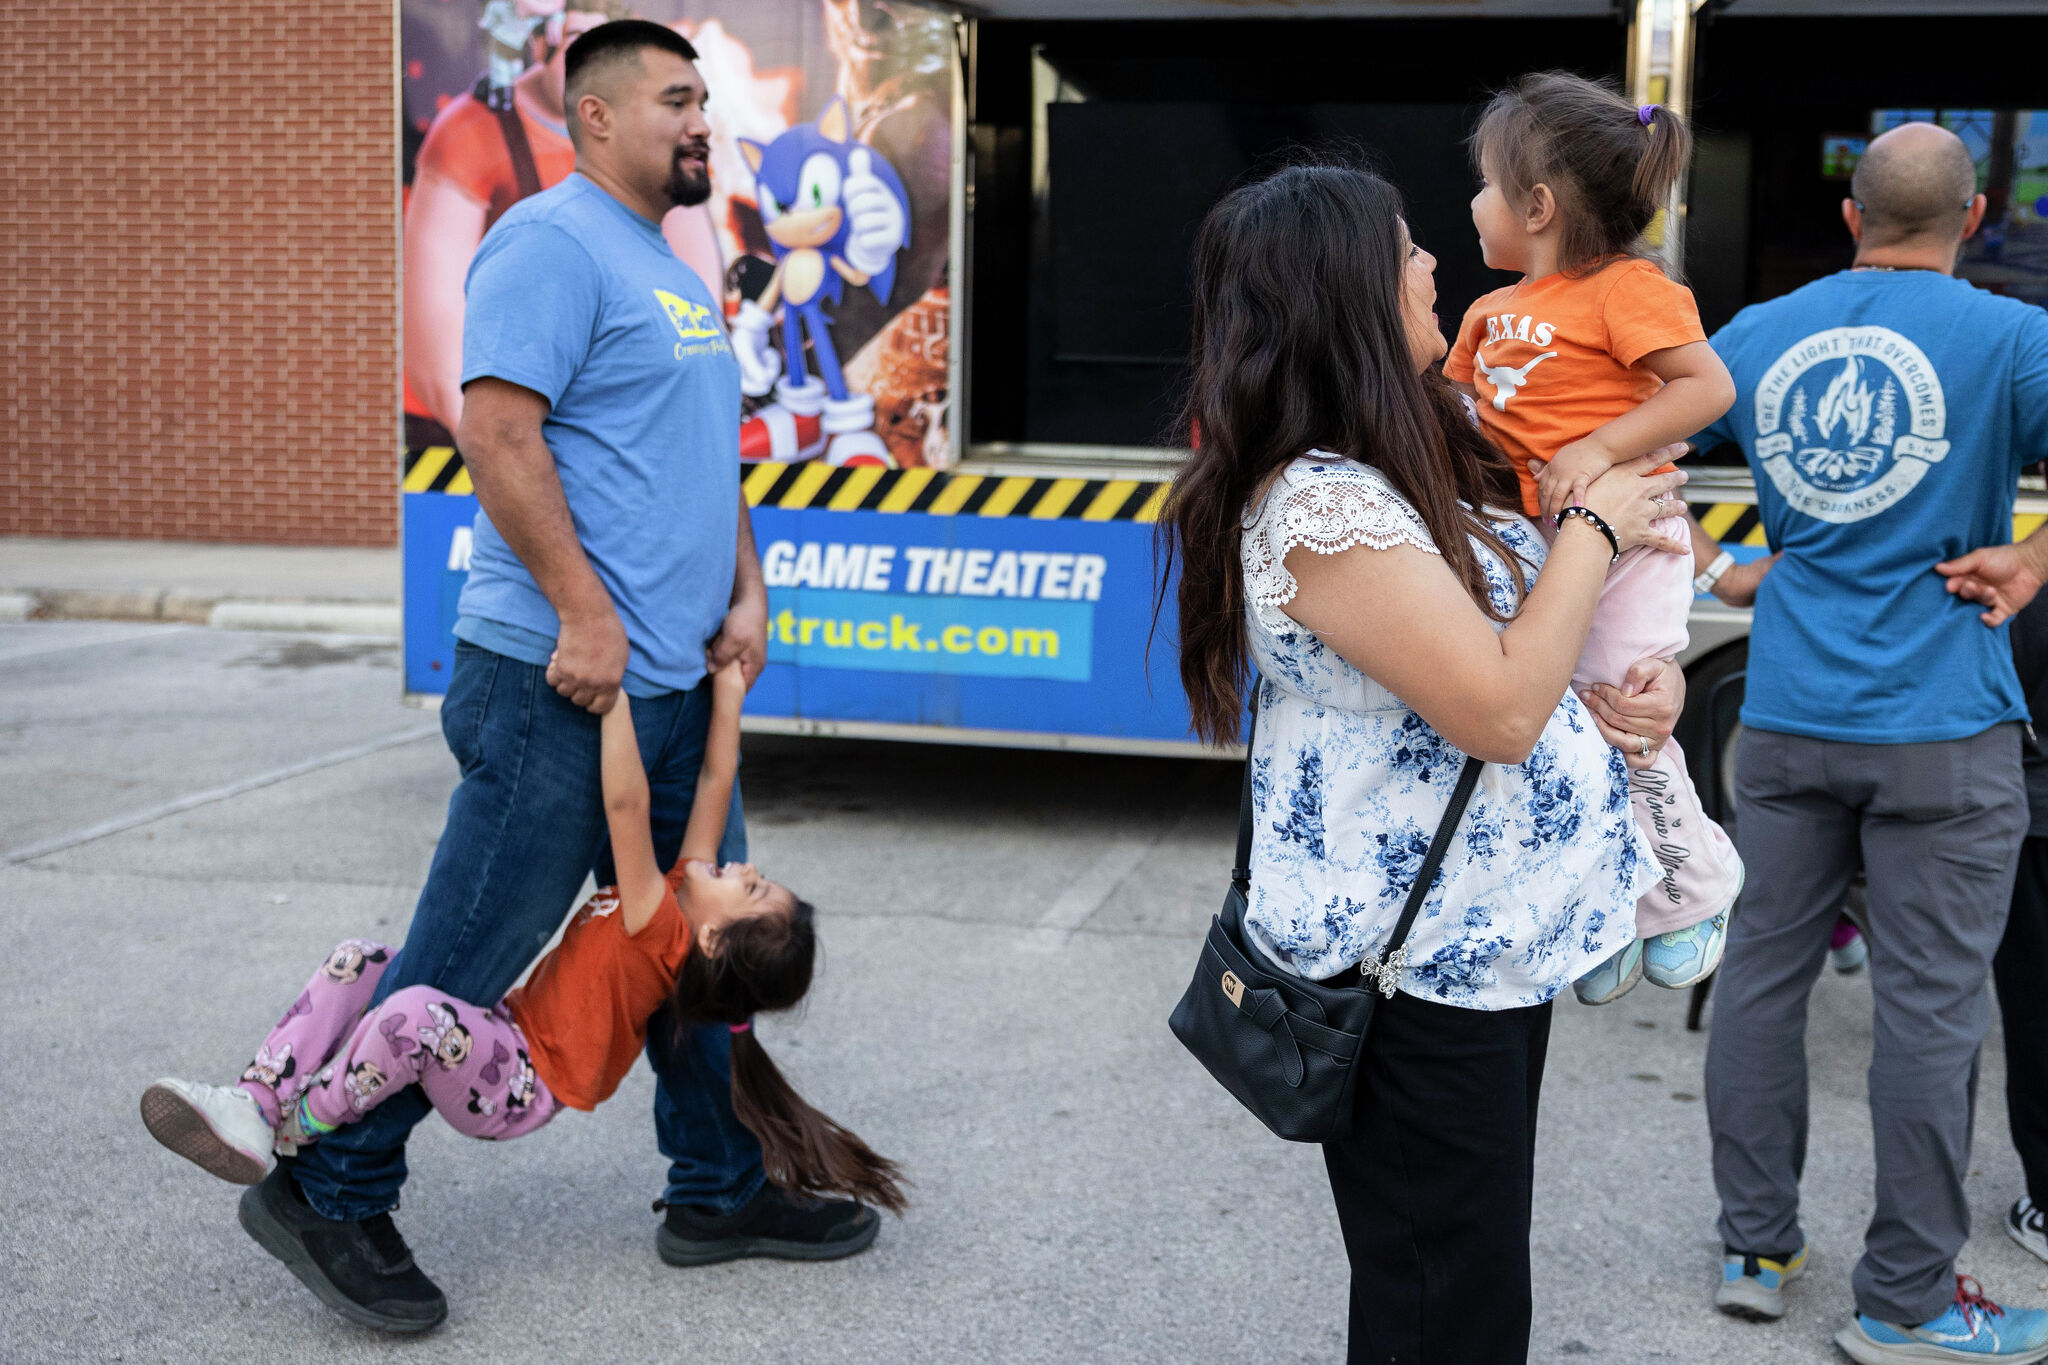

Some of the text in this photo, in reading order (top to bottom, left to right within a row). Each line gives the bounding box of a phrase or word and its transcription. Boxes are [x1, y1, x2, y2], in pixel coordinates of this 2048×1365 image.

[1485, 314, 1557, 347] EXAS
[1767, 367, 1792, 396] THE
[1792, 338, 1841, 368] LIGHT
[1884, 342, 1937, 428] OVERCOMES
[762, 541, 1107, 601] GAME THEATER
[1629, 769, 1691, 906] Minnie Mouse
